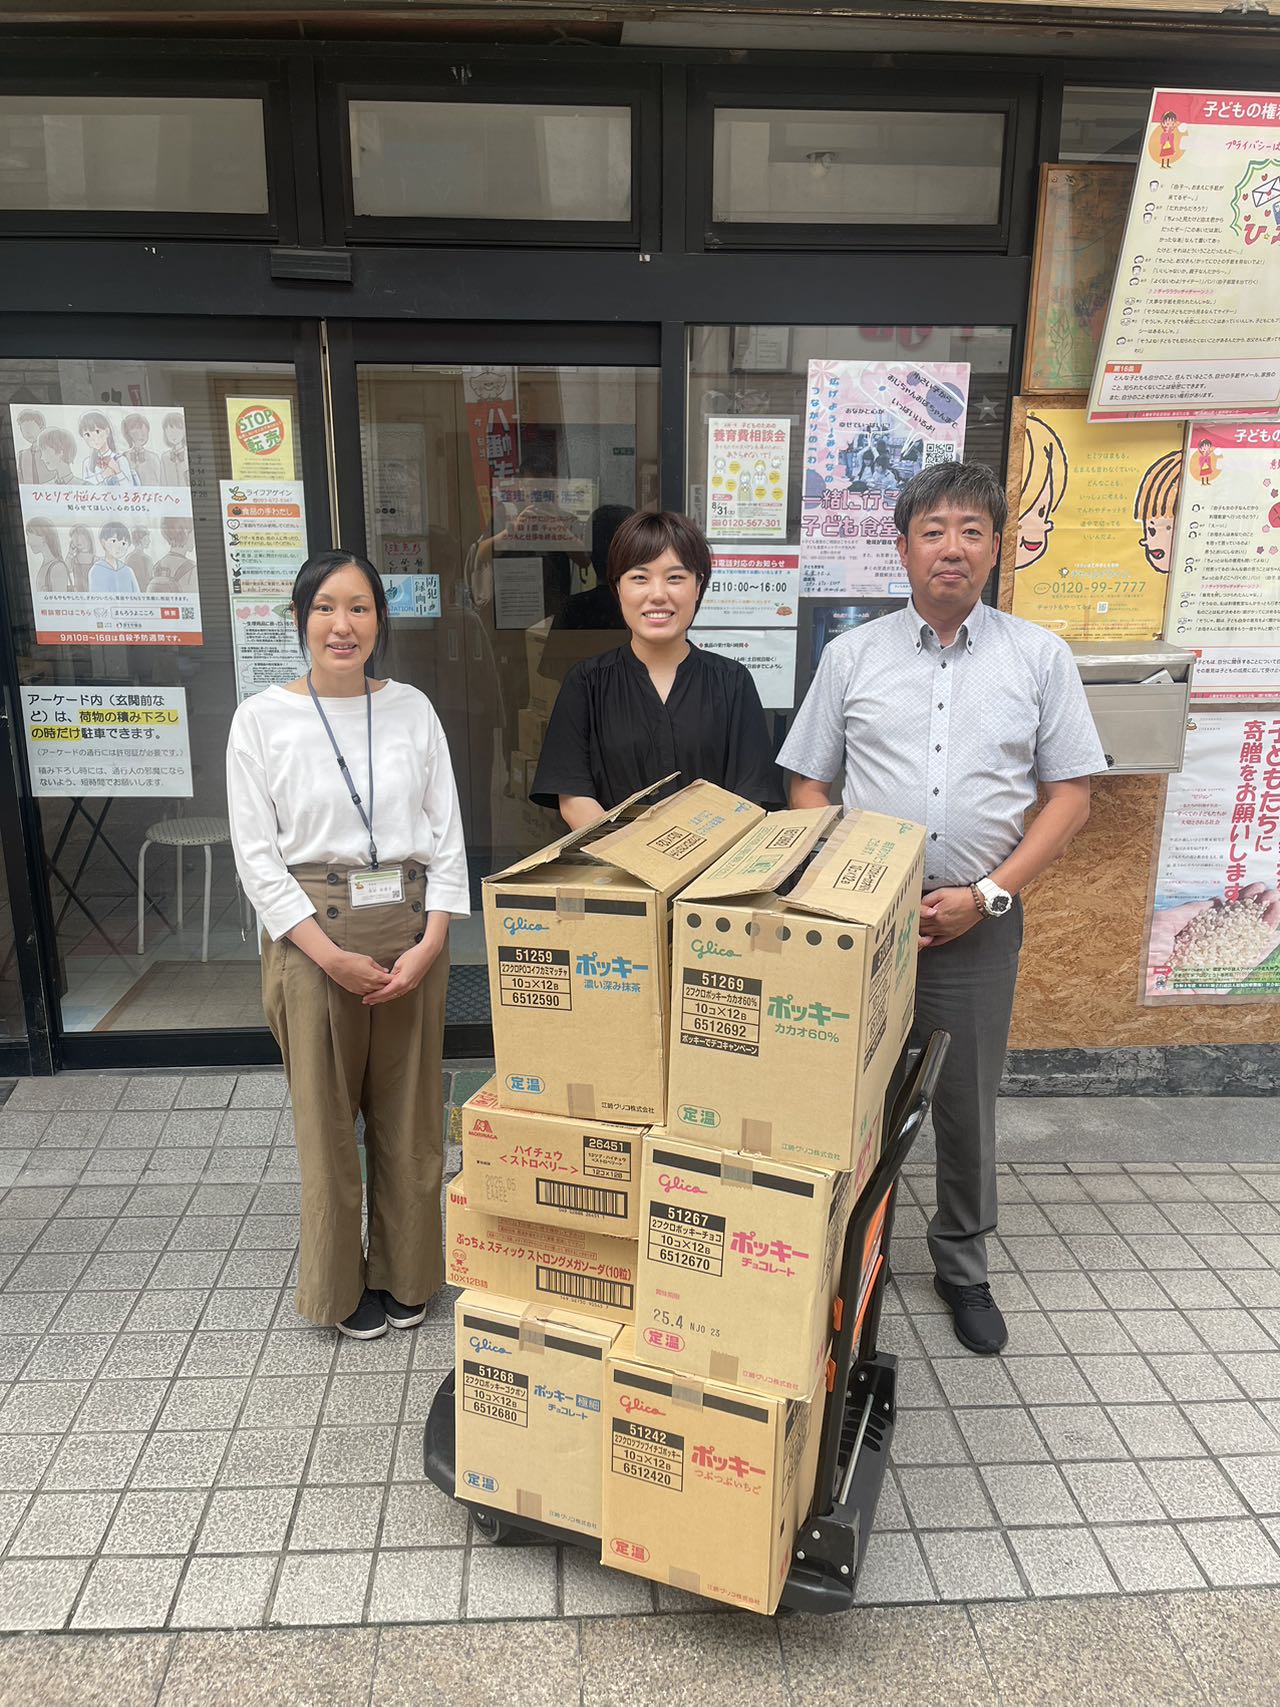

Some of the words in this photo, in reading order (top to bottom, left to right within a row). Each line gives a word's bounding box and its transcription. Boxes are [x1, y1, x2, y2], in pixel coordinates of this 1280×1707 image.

[239, 410, 273, 431] STOP
[246, 429, 281, 453] 転売
[713, 429, 786, 442] 養育費相談会
[32, 490, 181, 504] ひとりで悩んでいるあなたへ。
[241, 507, 293, 516] 食品の手わたし
[722, 519, 780, 527] 0120-567-301
[1052, 582, 1146, 593] 0120-99-7777
[27, 694, 165, 706] アーケード内（玄関前な
[30, 711, 178, 723] ど）は、荷物の積み下ろし
[32, 727, 161, 739] の時だけ駐車できます。
[37, 749, 184, 757] （アーケードの通行には許可証が必要です。）
[38, 767, 184, 775] 積み下ろし時には、通行人の邪魔になら
[39, 778, 165, 787] ないよう、短時間でお願いします。
[1224, 719, 1266, 902] 寄贈をお願いします
[503, 917, 549, 935] Glico
[515, 949, 553, 963] 51259
[690, 939, 742, 959] Glico
[575, 952, 649, 979] ポッキー
[511, 978, 559, 991] 10コ×12B
[584, 979, 641, 993] 濃い深み抹茶
[701, 973, 744, 992] 51269
[512, 992, 560, 1007] 6512590
[685, 986, 757, 1007] 2フクロポッキーカカオ60%
[695, 1003, 747, 1021] 10コ×12B
[767, 994, 850, 1026] ポッキー
[694, 1018, 746, 1038] 6512692
[775, 1023, 840, 1043] カカオ60%
[682, 1034, 758, 1055] ポッキーでデコキャンペーン
[510, 1077, 540, 1092] 定温
[601, 1101, 655, 1114] 江崎グリコ株式会社
[683, 1106, 715, 1126] 定温
[514, 1145, 563, 1160] ハイチュウ
[589, 1138, 624, 1152] 26451
[781, 1142, 841, 1161] 江崎グリコ株式会社
[658, 1174, 708, 1194] Glico
[667, 1207, 709, 1227] 51267
[652, 1218, 722, 1242] 2フクロポッキーチョコ
[660, 1234, 711, 1255] 10コ×12B
[730, 1230, 810, 1263] ポッキー
[456, 1233, 485, 1251] ぷっちょ
[488, 1241, 525, 1258] スティック
[527, 1250, 632, 1281] ストロングメガソーダ(10粒)
[660, 1250, 710, 1271] 6512670
[741, 1257, 795, 1277] チョコレート
[653, 1307, 683, 1330] 25.4
[469, 1336, 512, 1355] Glico
[648, 1330, 679, 1350] 定温
[478, 1365, 515, 1384] 51268
[742, 1369, 799, 1391] 江崎グリコ株式会社
[465, 1375, 526, 1398] 2フクロポッキーゴクボソ
[534, 1384, 574, 1403] ポッキー
[474, 1389, 517, 1408] 10コ×12B
[619, 1394, 666, 1416] Glico
[473, 1403, 517, 1422] 6512680
[548, 1403, 588, 1421] チョコレート
[629, 1423, 667, 1445] 51242
[614, 1433, 681, 1459] 2フクロツブツブイチゴポッキー
[623, 1449, 671, 1471] 10コ×12B
[691, 1444, 766, 1478] ポッキー
[467, 1472, 494, 1491] 定温
[623, 1462, 671, 1486] 6512420
[694, 1469, 762, 1495] つぶつぶいちご
[615, 1540, 645, 1561] 定温
